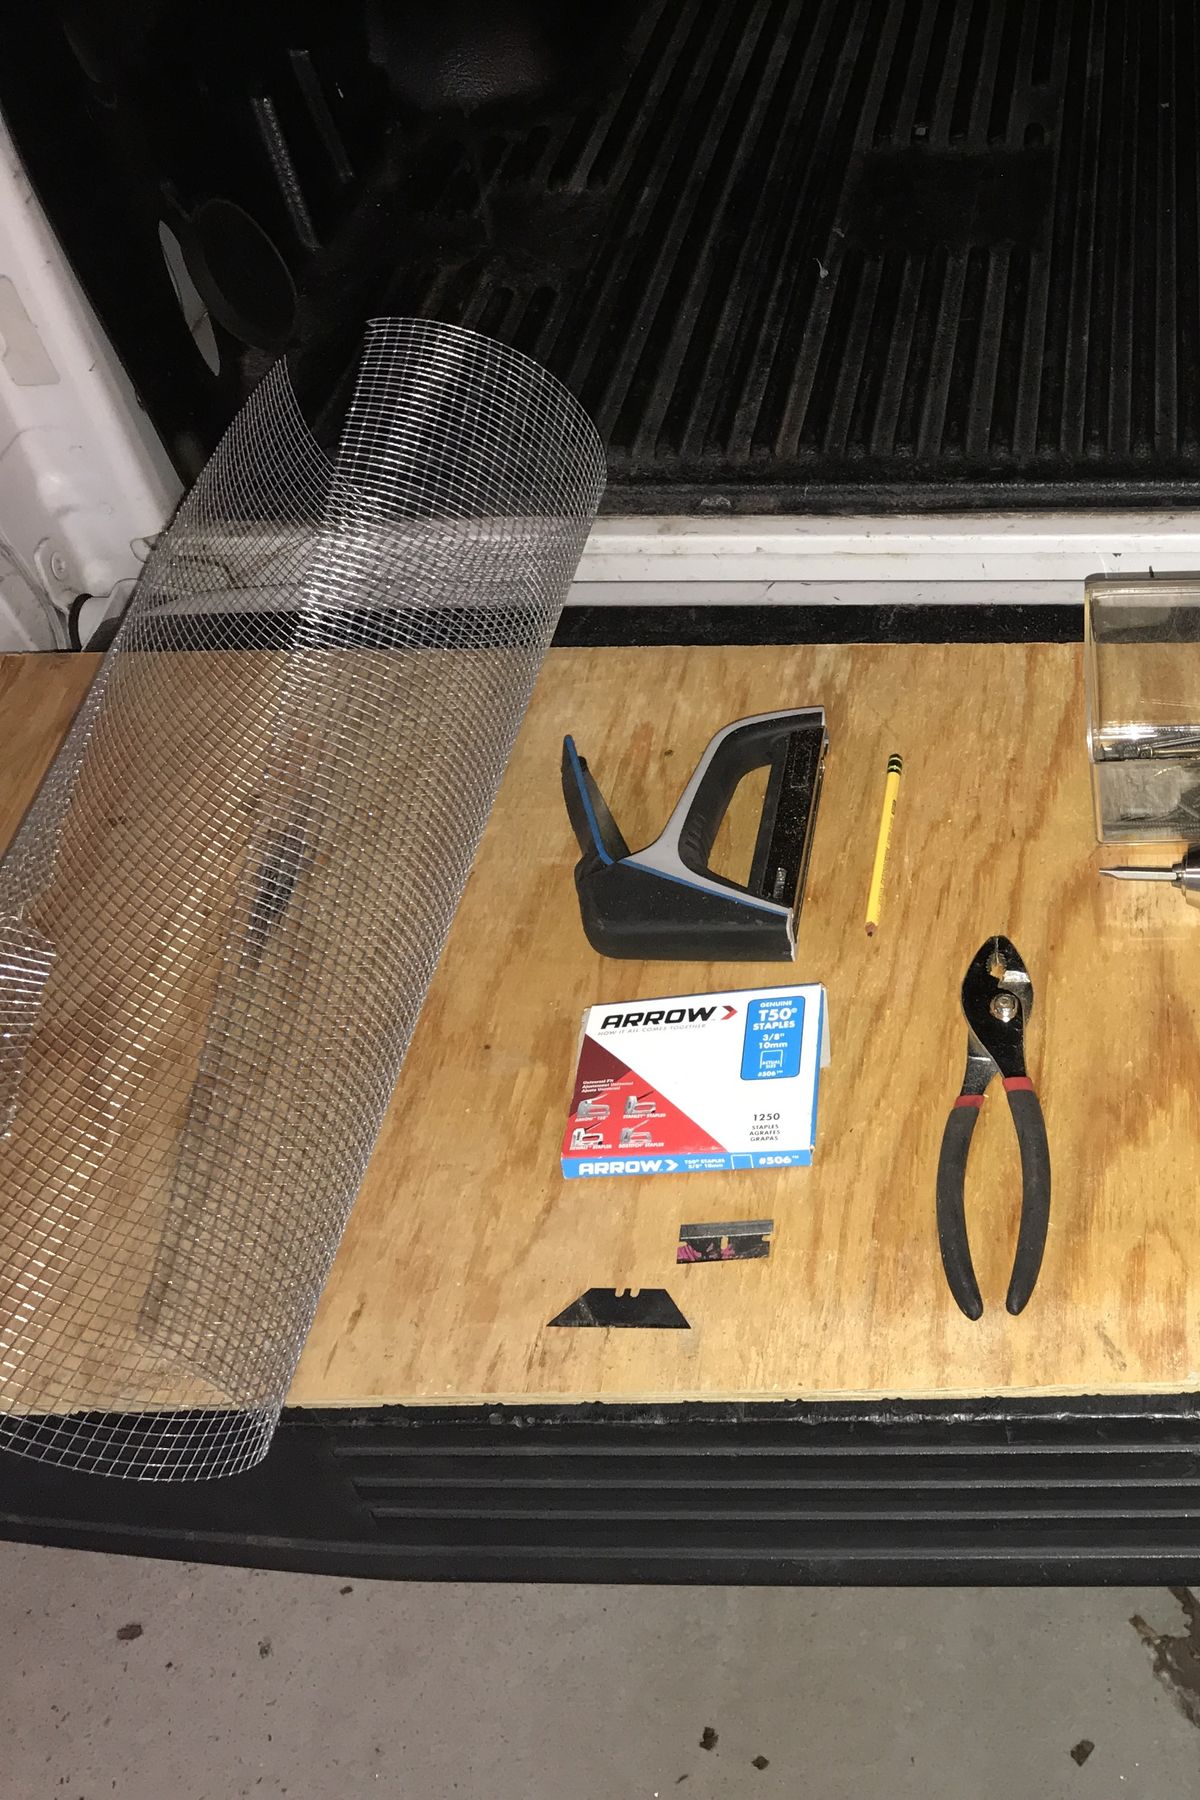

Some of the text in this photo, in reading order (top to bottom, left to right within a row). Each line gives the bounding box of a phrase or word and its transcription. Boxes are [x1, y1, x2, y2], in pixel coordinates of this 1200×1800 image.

[600, 1006, 717, 1029] ARROW
[753, 1020, 796, 1031] STAPLES
[762, 1033, 785, 1041] 3/8"
[753, 1113, 780, 1121] 1250
[578, 1159, 660, 1175] ARROW
